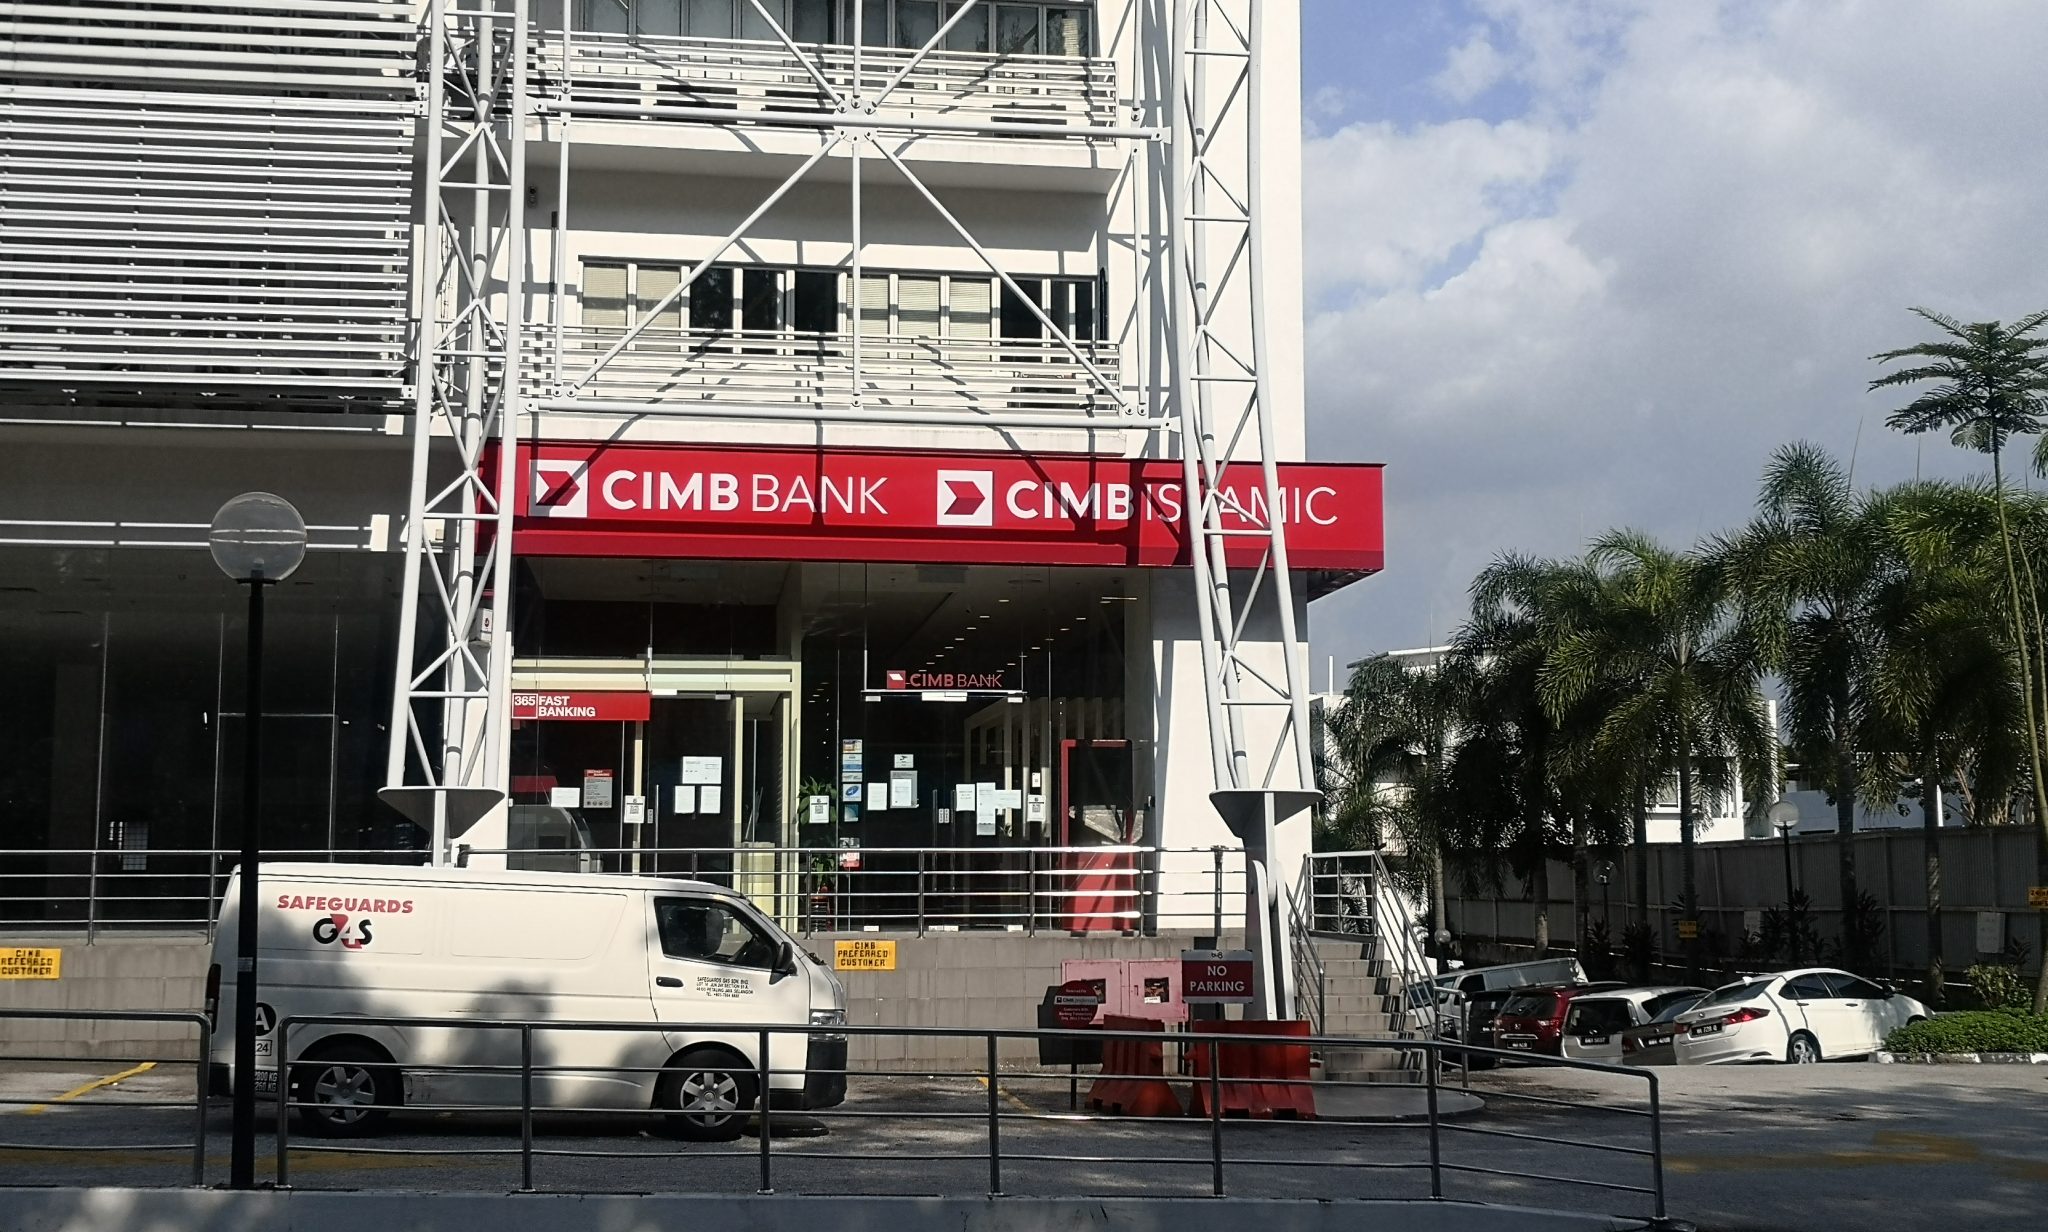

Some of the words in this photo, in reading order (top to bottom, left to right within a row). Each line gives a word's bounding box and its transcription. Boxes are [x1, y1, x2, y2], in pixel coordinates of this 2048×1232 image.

[602, 470, 739, 511] CIMB
[752, 474, 888, 514] BANK
[1006, 480, 1133, 520] CIMB
[1146, 484, 1338, 525] ISAMIC
[909, 673, 954, 687] CIMB
[957, 674, 1002, 687] BANK
[514, 695, 536, 706] 365
[538, 695, 570, 706] FAST
[538, 706, 596, 717] BANKING
[277, 895, 414, 913] SAFEGUARDS
[313, 913, 373, 949] G4S
[0, 957, 53, 966] REFERRED
[1, 967, 52, 975] CUSTOMER
[1207, 965, 1227, 976] NO
[1190, 981, 1245, 992] PARKING
[256, 1006, 270, 1031] A
